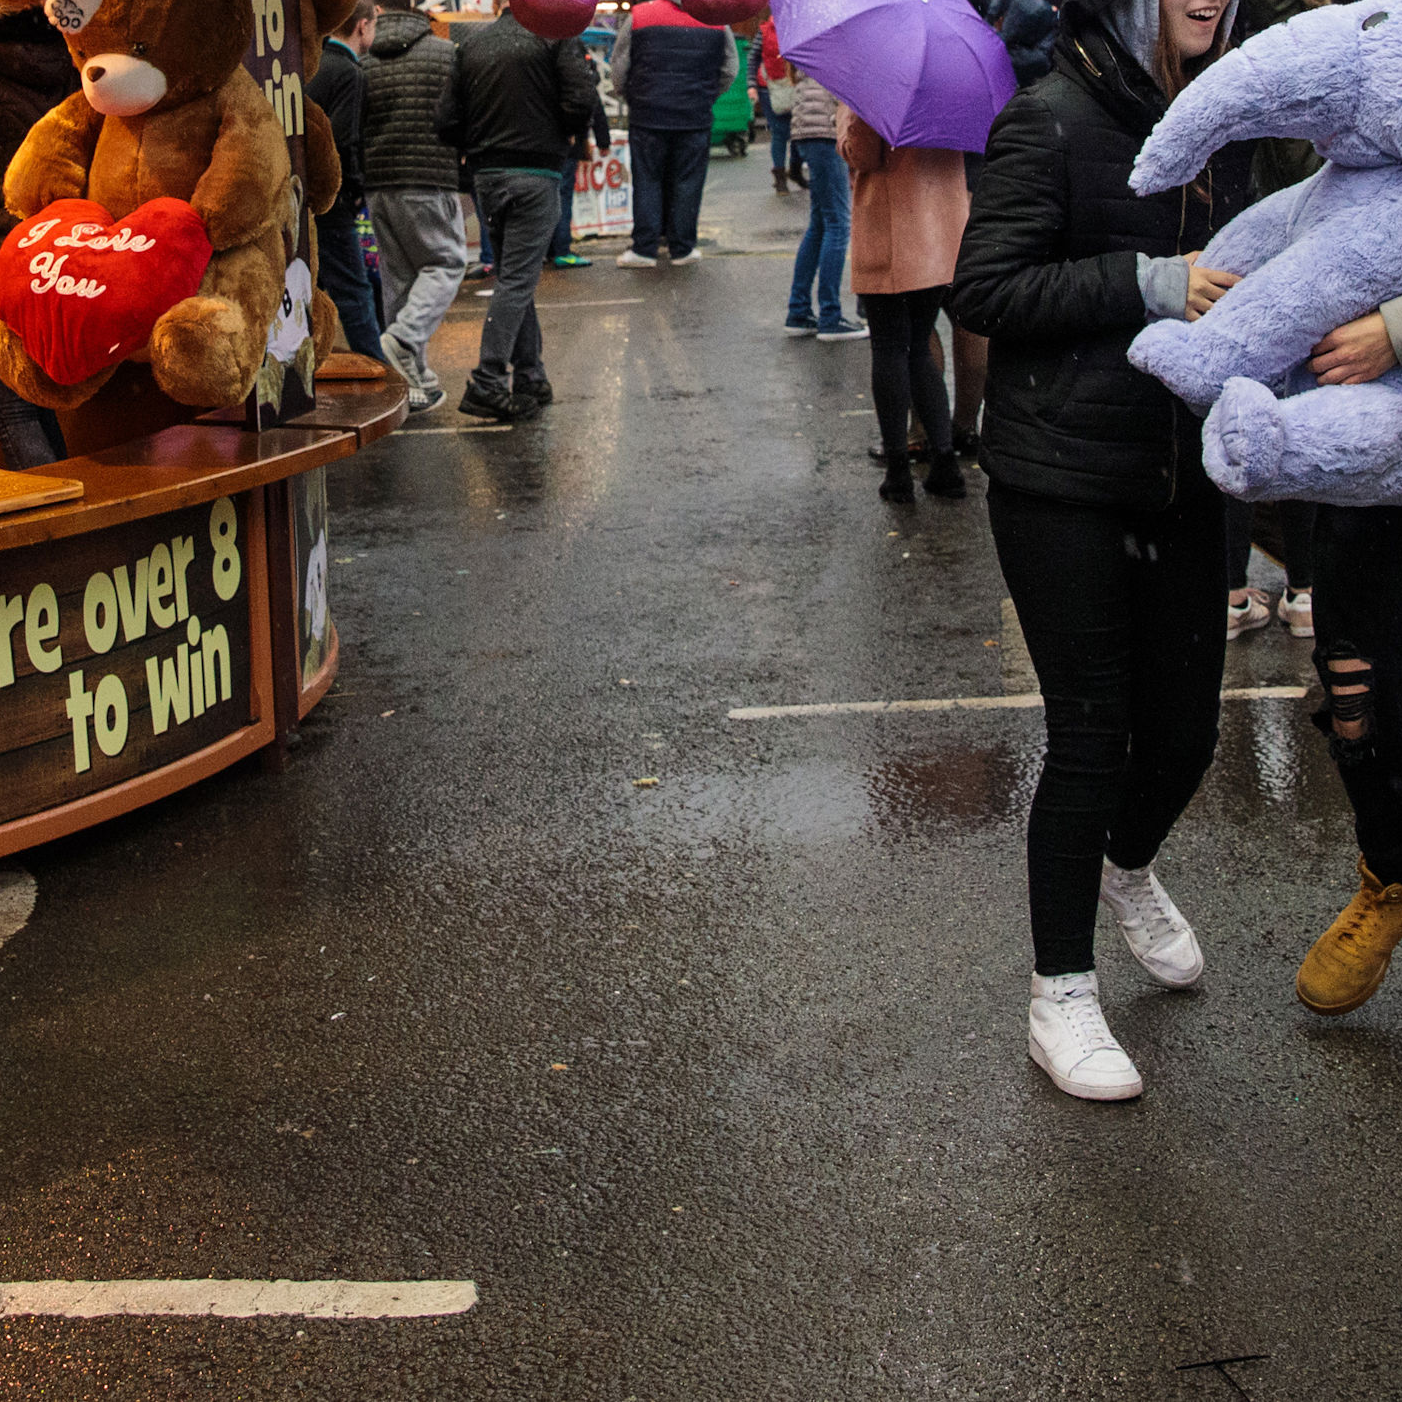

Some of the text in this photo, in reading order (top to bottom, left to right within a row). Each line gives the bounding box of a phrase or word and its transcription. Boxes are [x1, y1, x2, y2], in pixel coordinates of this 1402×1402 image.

[17, 218, 156, 254] I Love
[29, 251, 107, 299] You
[82, 533, 196, 656] over
[209, 495, 242, 602] 8
[65, 614, 233, 774] to win
